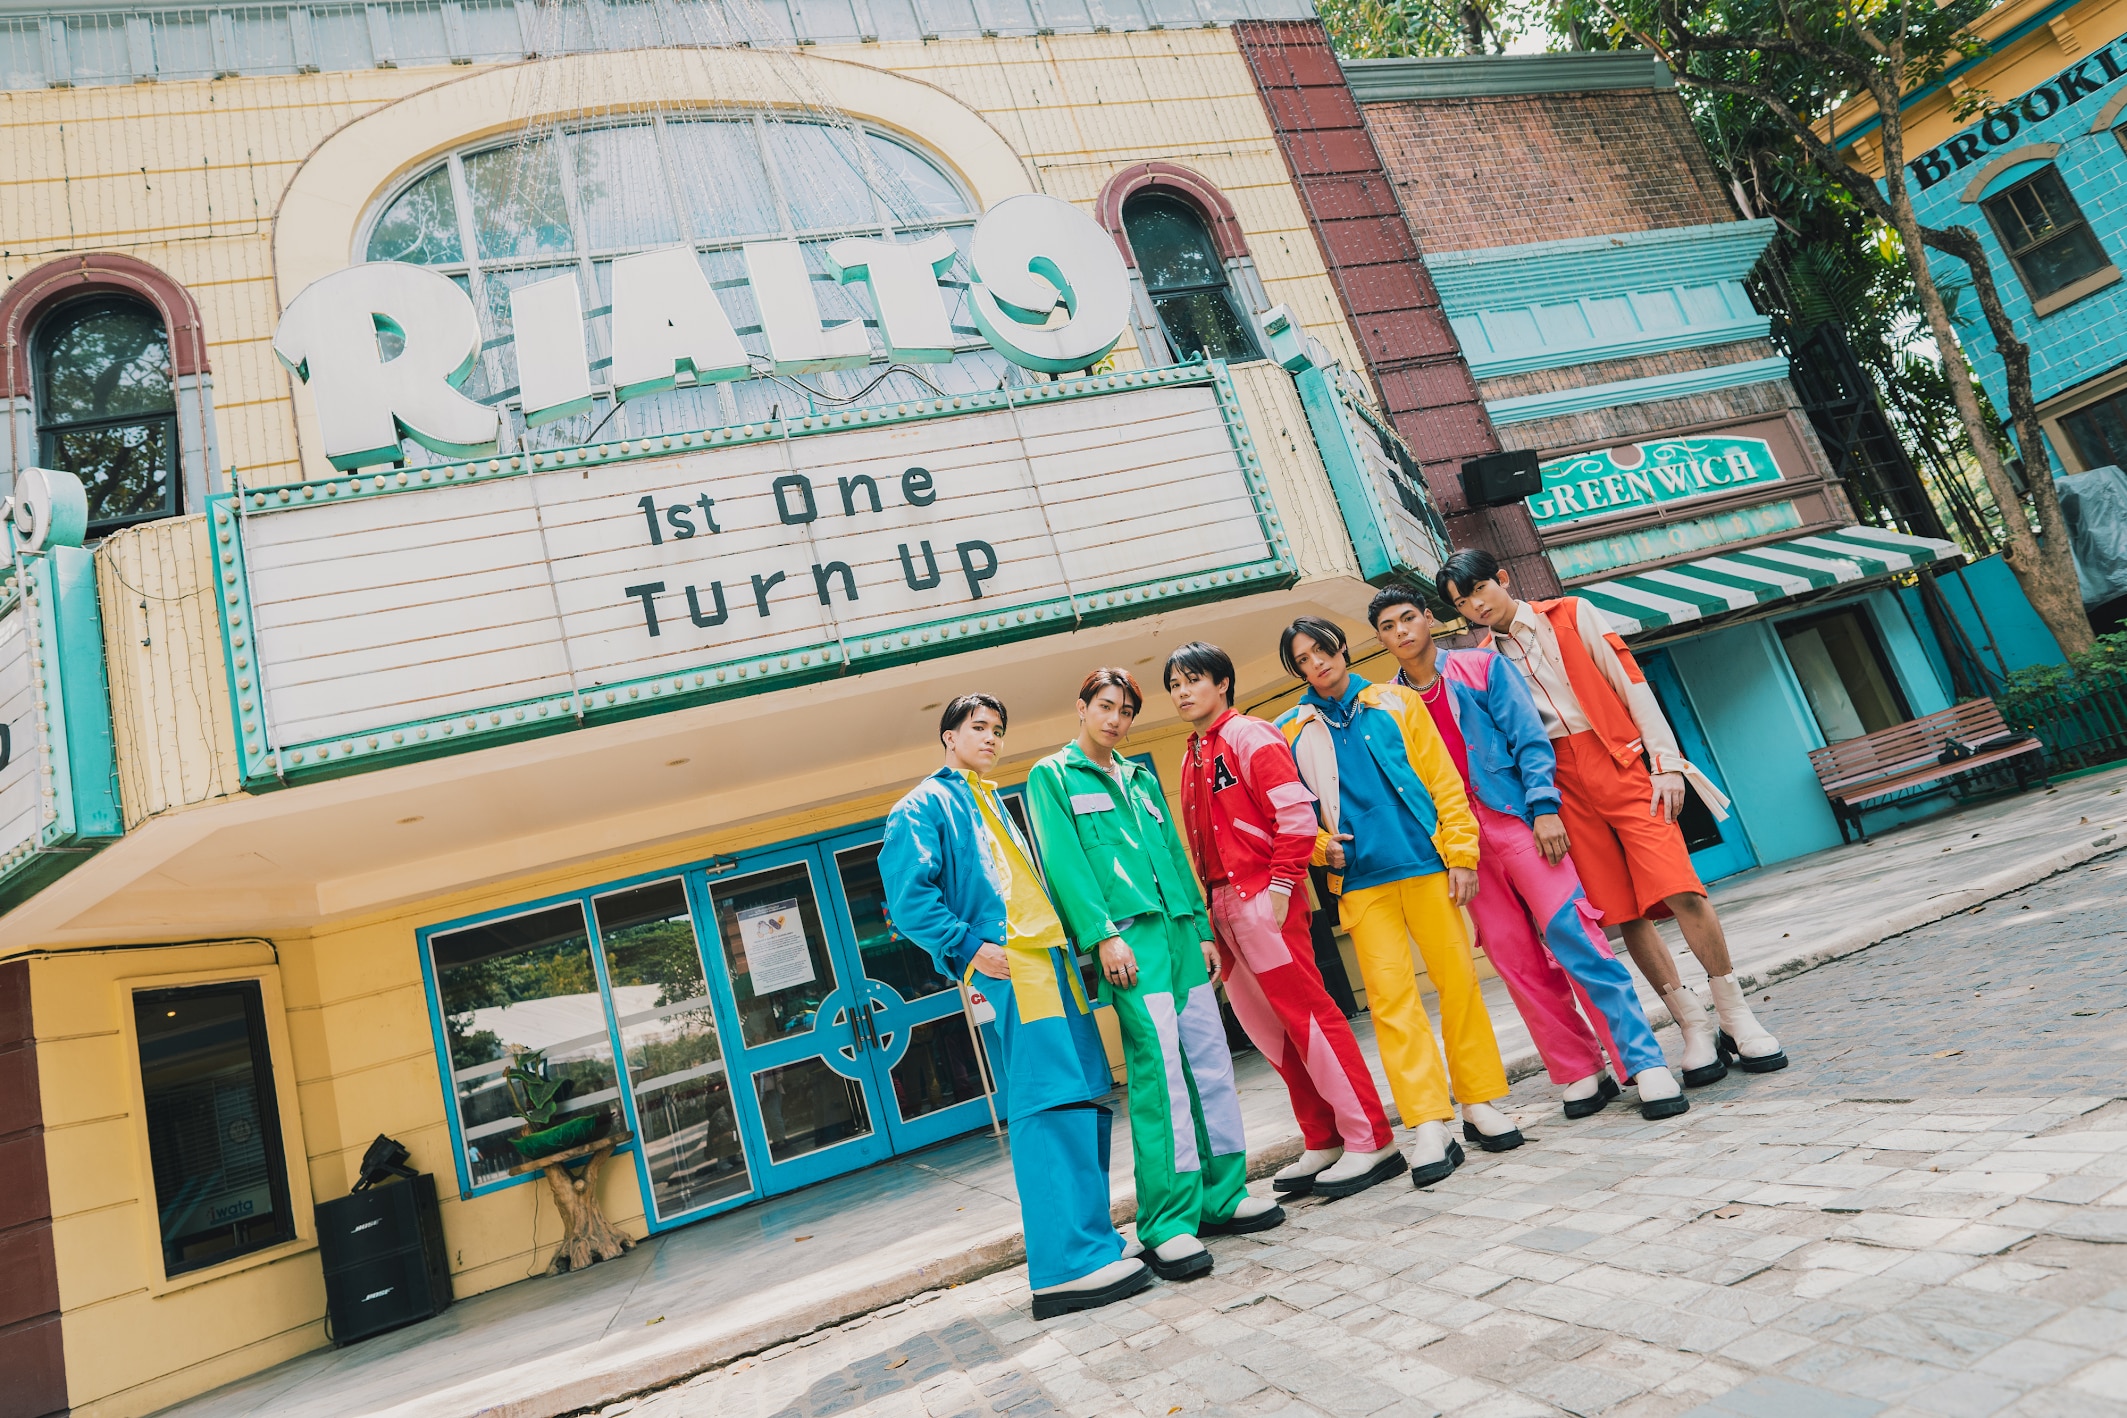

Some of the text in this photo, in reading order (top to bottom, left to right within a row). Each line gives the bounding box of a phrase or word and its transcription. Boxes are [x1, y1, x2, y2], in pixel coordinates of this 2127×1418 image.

[273, 194, 1132, 470] RIALTO
[637, 466, 937, 546] 1st One
[1526, 451, 1758, 519] GREENWICH
[1554, 511, 1775, 574] NTIQUES
[624, 540, 998, 638] Turn Up
[1213, 753, 1238, 793] A
